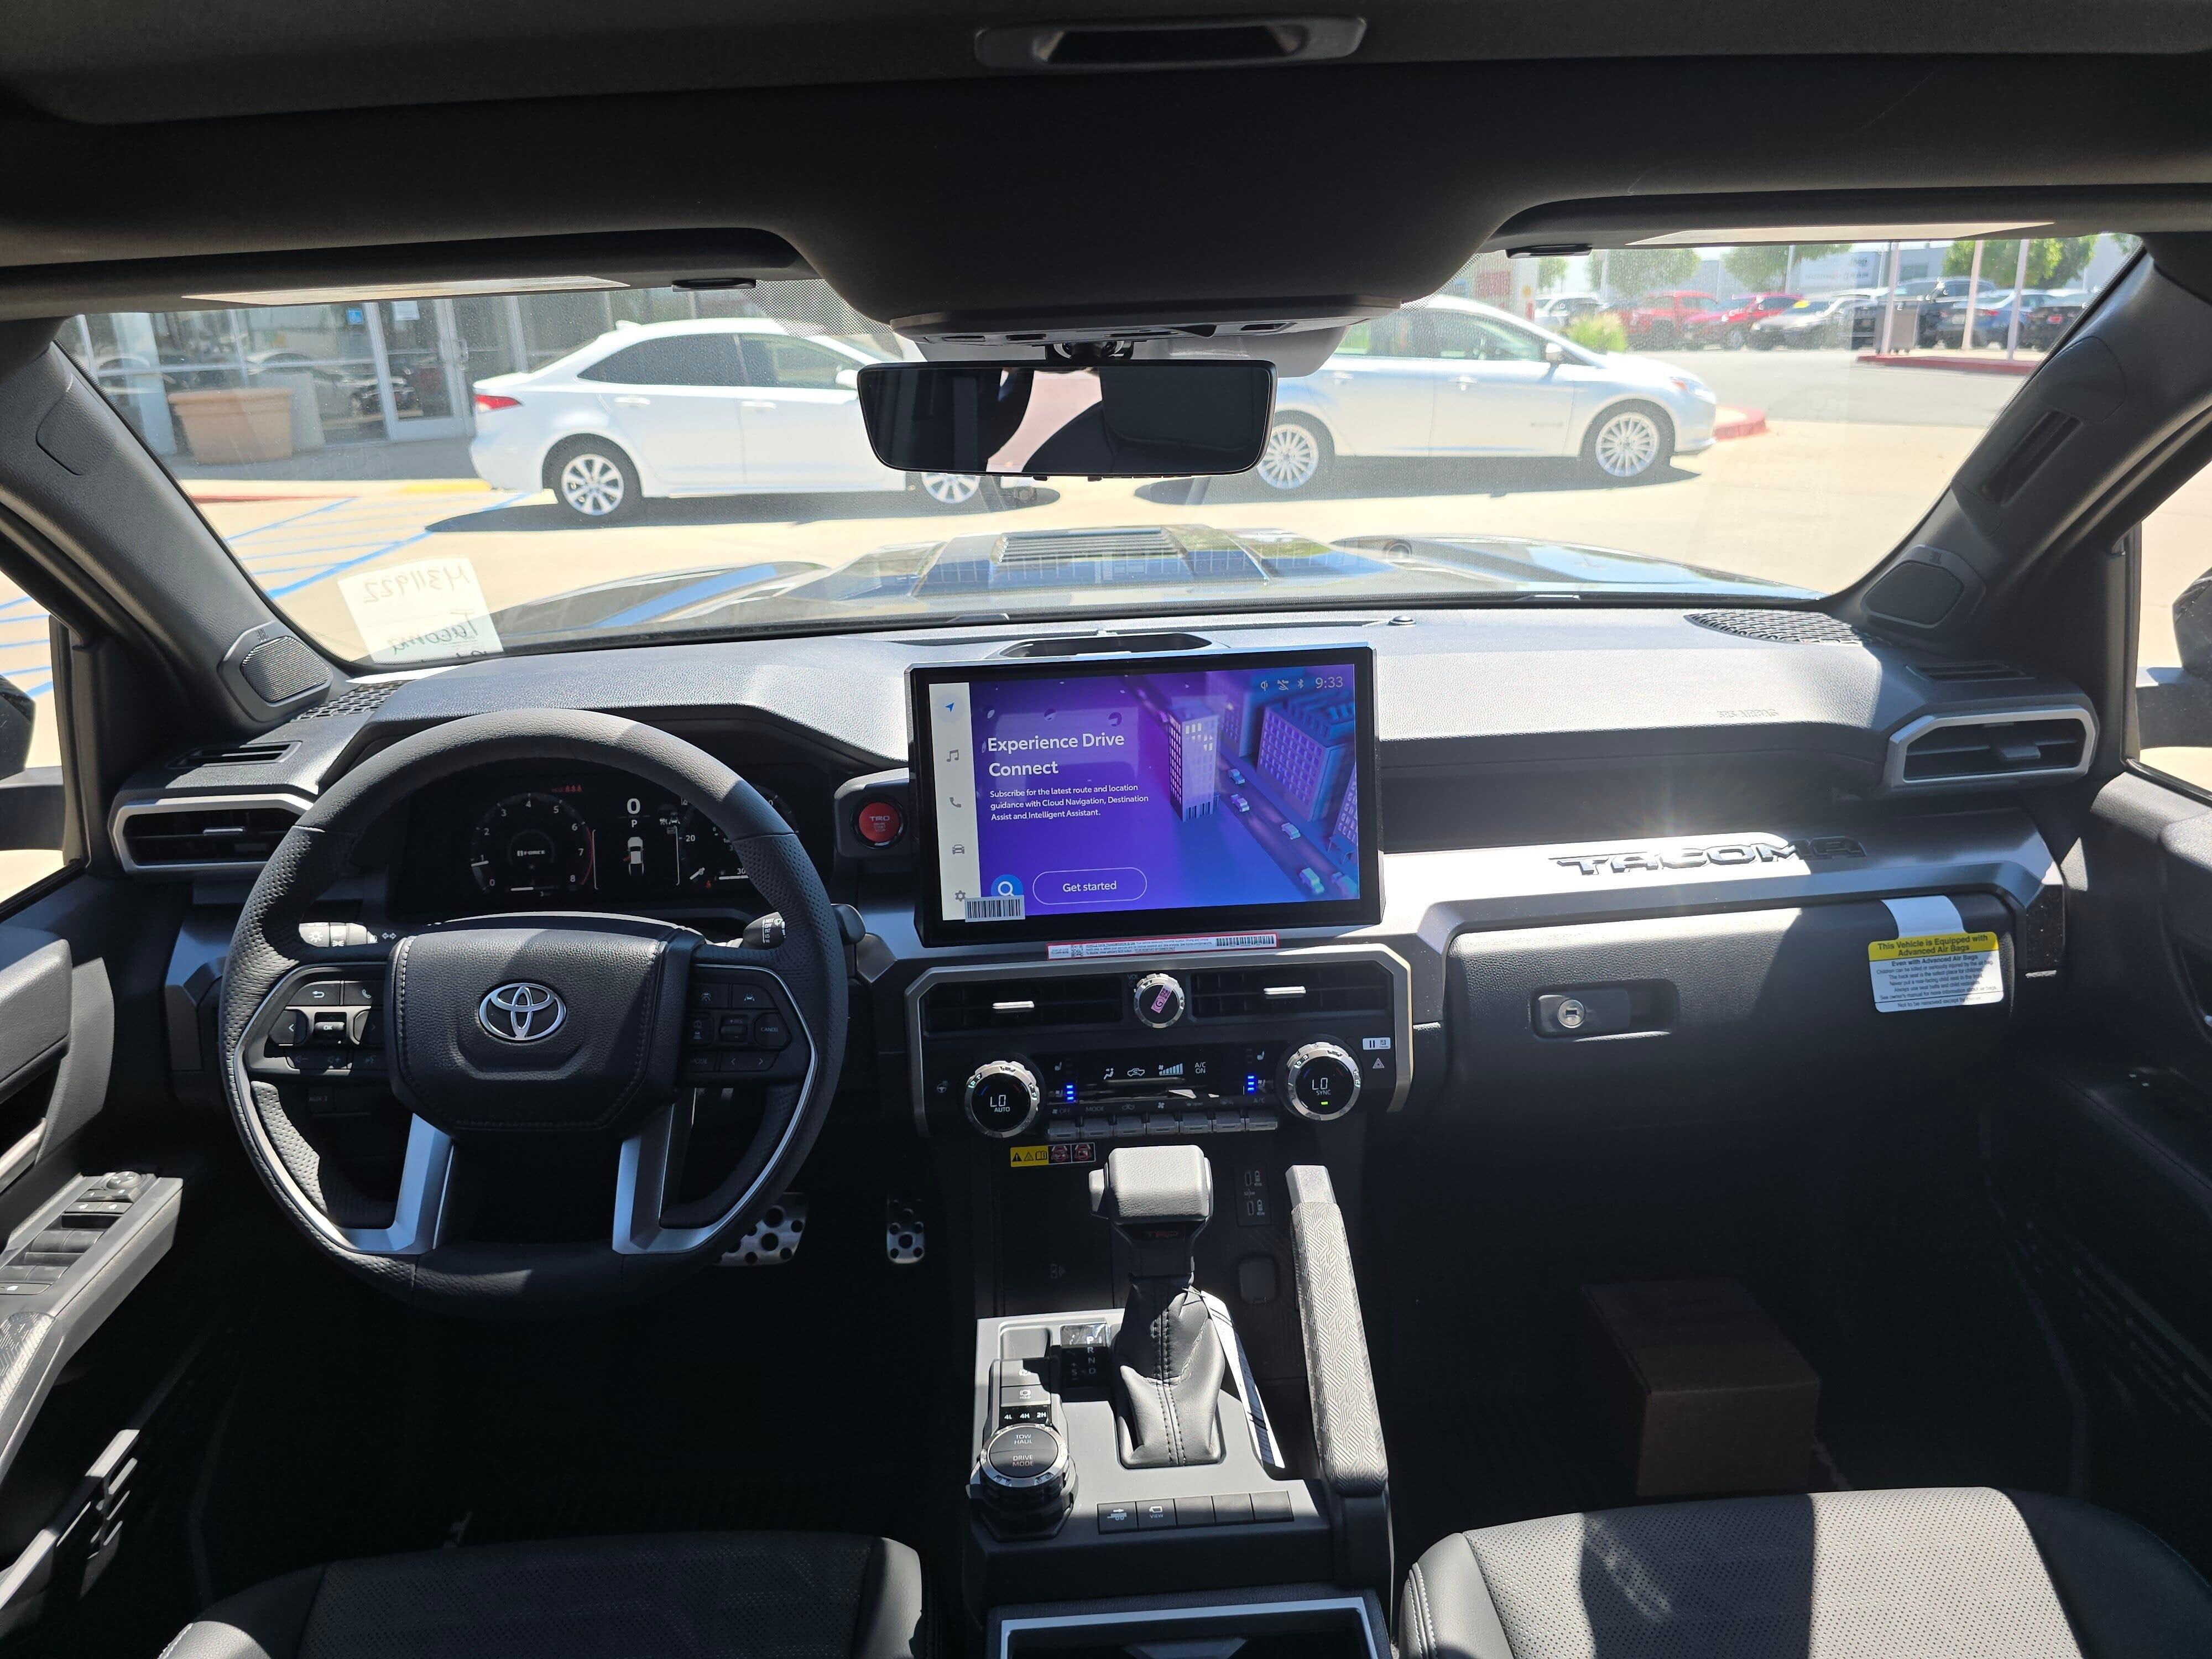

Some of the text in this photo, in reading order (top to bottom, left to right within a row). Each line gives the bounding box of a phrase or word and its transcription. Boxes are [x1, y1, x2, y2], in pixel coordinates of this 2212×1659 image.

[1315, 676, 1343, 688] 9:33
[1738, 709, 1778, 718] AIRBAG
[988, 732, 1124, 754] Experience Drive
[989, 761, 1058, 777] Connect
[990, 789, 1025, 798] Subscribe
[1073, 786, 1092, 794] route
[1093, 785, 1107, 793] and
[1109, 784, 1138, 792] location
[627, 798, 641, 815] 0
[990, 800, 1024, 811] guidance
[1042, 799, 1064, 807] Cloud
[1065, 797, 1106, 807] Navigation,
[1108, 795, 1149, 804] Destination
[500, 809, 507, 817] 3
[991, 812, 1011, 821] Assist
[1028, 810, 1065, 820] Intelligent
[1066, 809, 1101, 817] Assistant.
[632, 820, 638, 828] P
[578, 848, 584, 856] 7
[1556, 836, 1867, 875] TACOMA
[570, 874, 576, 883] 8
[1062, 880, 1117, 892] Get started
[1896, 940, 1924, 948] Vehicle
[1934, 936, 1970, 947] Equipped
[1898, 947, 1935, 957] Advanced
[1312, 1077, 1328, 1090] LO
[990, 1094, 1006, 1107] LO
[1086, 1335, 1094, 1344] P
